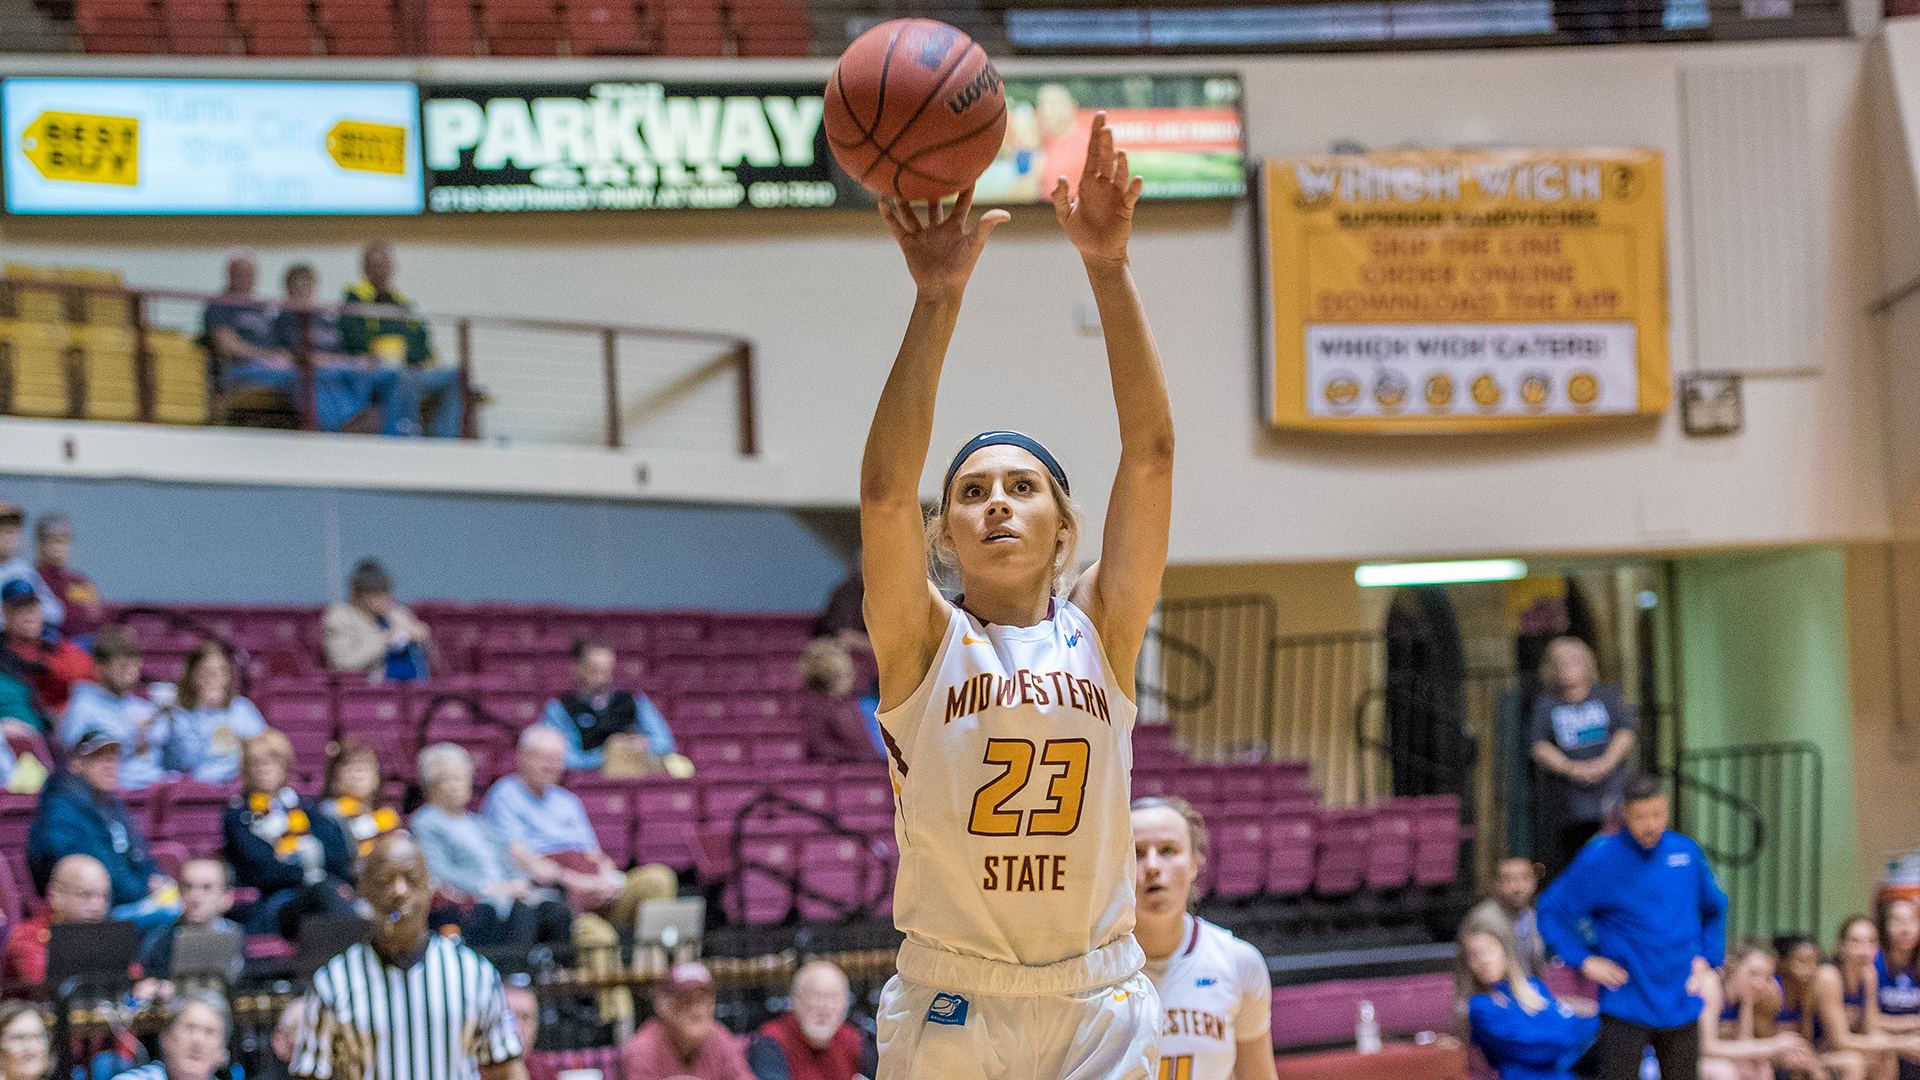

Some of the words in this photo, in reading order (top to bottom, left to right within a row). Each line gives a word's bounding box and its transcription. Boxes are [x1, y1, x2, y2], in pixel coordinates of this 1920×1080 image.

[43, 117, 136, 147] BEST
[423, 97, 825, 171] PARKWAY
[46, 148, 127, 176] BUY
[1294, 162, 1460, 203] WHICH
[1472, 162, 1602, 201] WICH
[1370, 234, 1430, 257] SKIP
[1440, 234, 1489, 257] THE
[1500, 233, 1563, 256] LINE
[1358, 263, 1457, 286] ORDER
[1467, 263, 1577, 285] ONLINE
[1317, 291, 1498, 315] DOWNLOAD
[1505, 291, 1557, 313] THE
[1571, 289, 1621, 312] APP
[1318, 337, 1408, 360] WHICH
[1415, 337, 1486, 360] WICH
[943, 669, 1112, 726] MIDWESTERN
[967, 737, 1091, 837] 23
[982, 854, 1067, 893] STATE
